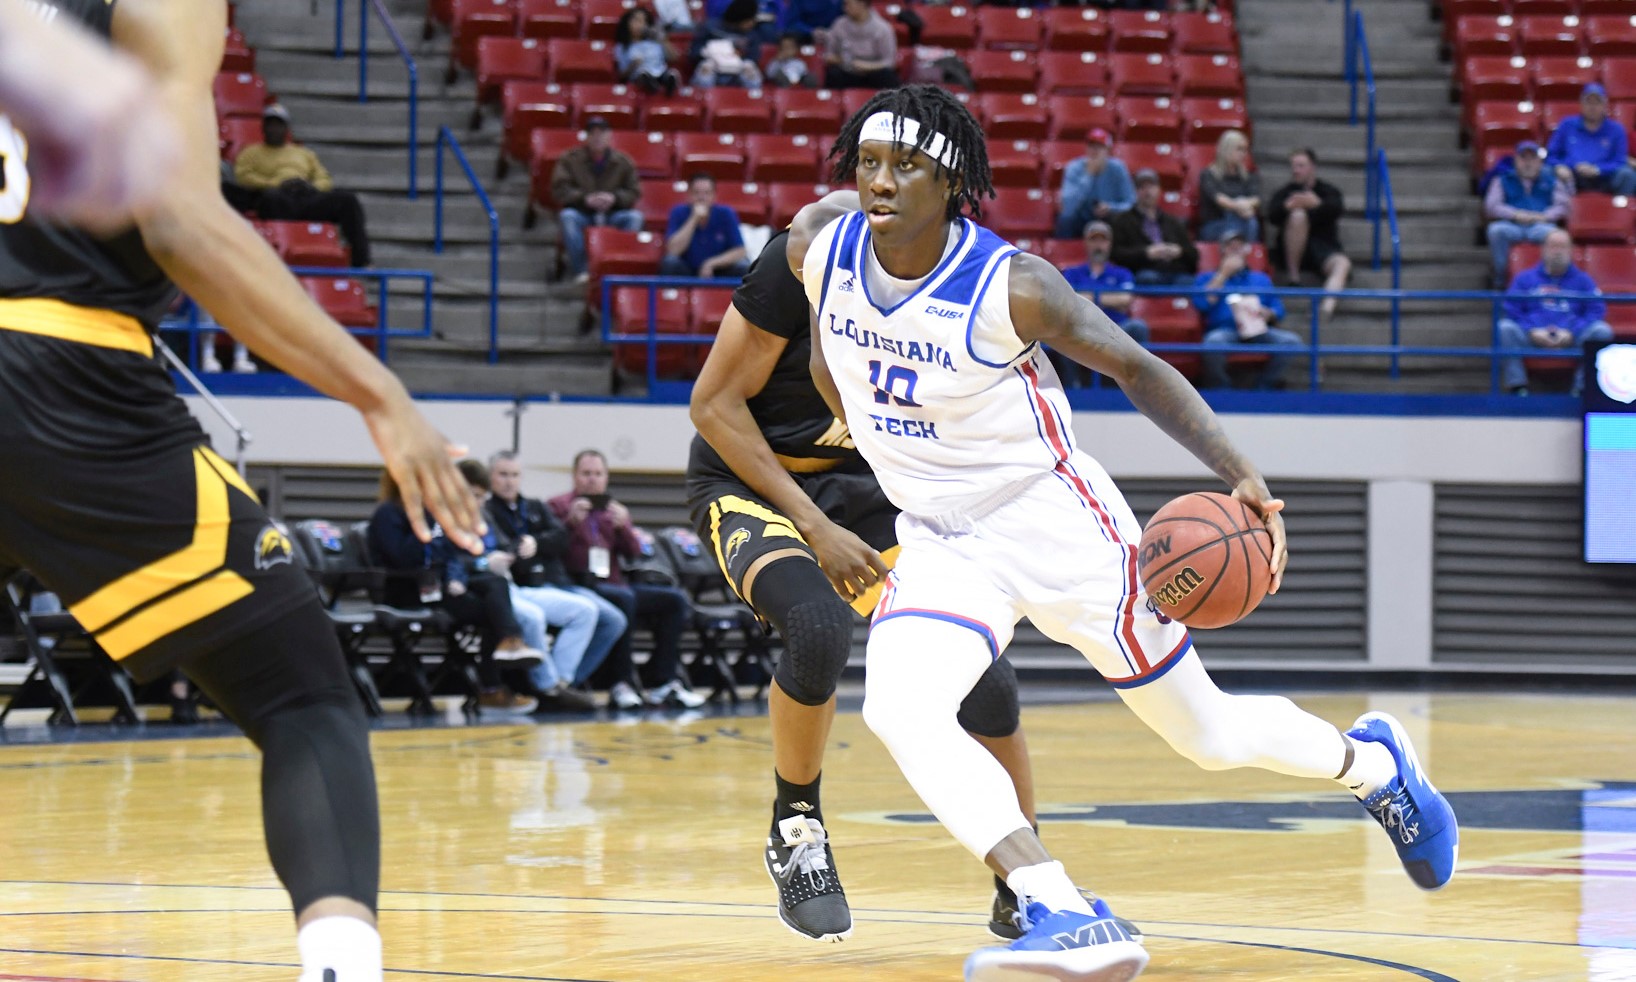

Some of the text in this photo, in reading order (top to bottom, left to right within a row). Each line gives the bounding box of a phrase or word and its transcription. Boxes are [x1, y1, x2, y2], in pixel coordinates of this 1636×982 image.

[829, 313, 957, 373] LOUISIANA
[868, 360, 923, 408] 10
[868, 413, 940, 440] TECH
